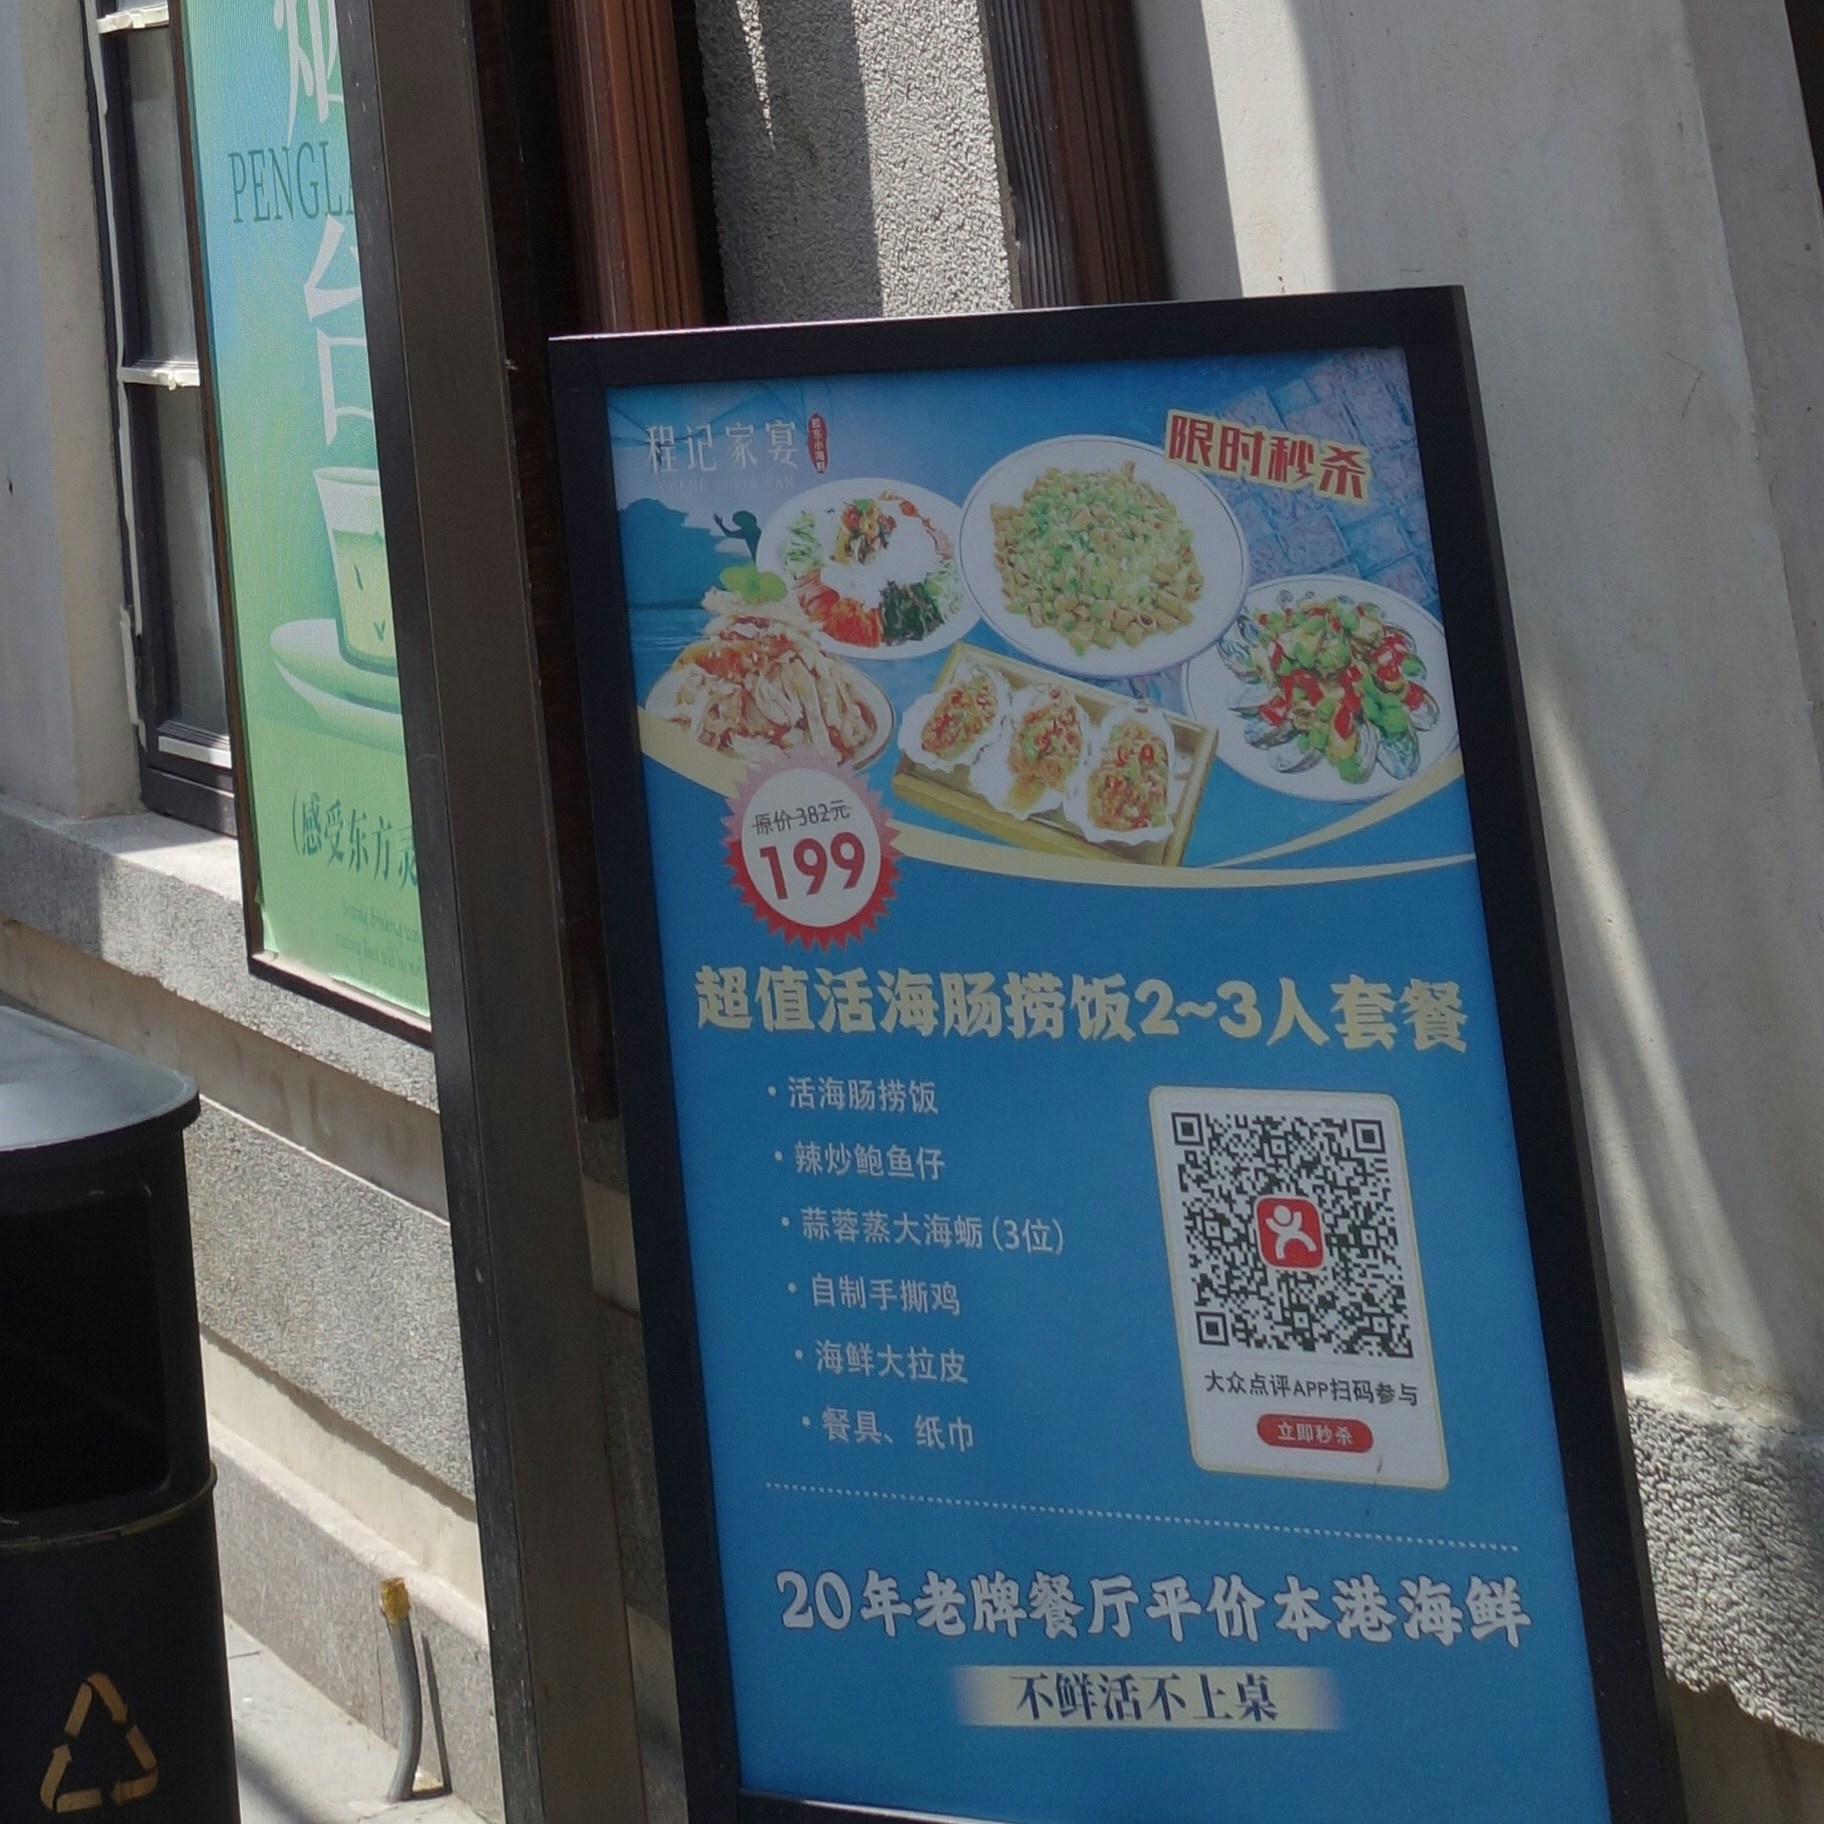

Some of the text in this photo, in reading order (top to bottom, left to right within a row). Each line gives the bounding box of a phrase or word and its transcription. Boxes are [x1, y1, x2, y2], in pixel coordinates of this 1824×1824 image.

[646, 419, 799, 474] 程记家宴
[1168, 414, 1367, 500] 限时秒杀
[759, 831, 866, 901] 199
[695, 965, 1470, 1056] 超值活海肠捞饭2~3人套餐
[789, 1075, 939, 1115] 活海肠捞饭
[794, 1140, 946, 1181] 辣炒鲍鱼仔
[811, 1273, 962, 1317] 自制手撕鸡
[815, 1339, 969, 1384] 海鲜大拉皮
[1204, 1369, 1419, 1407] 大众点评APP扫码参与
[821, 1407, 974, 1453] 餐具、纸巾
[1276, 1421, 1354, 1445] 立即秒杀
[774, 1566, 1532, 1649] 20年老牌餐厅平价本港海鲜
[1010, 1669, 1280, 1726] 不鲜活不上桌
